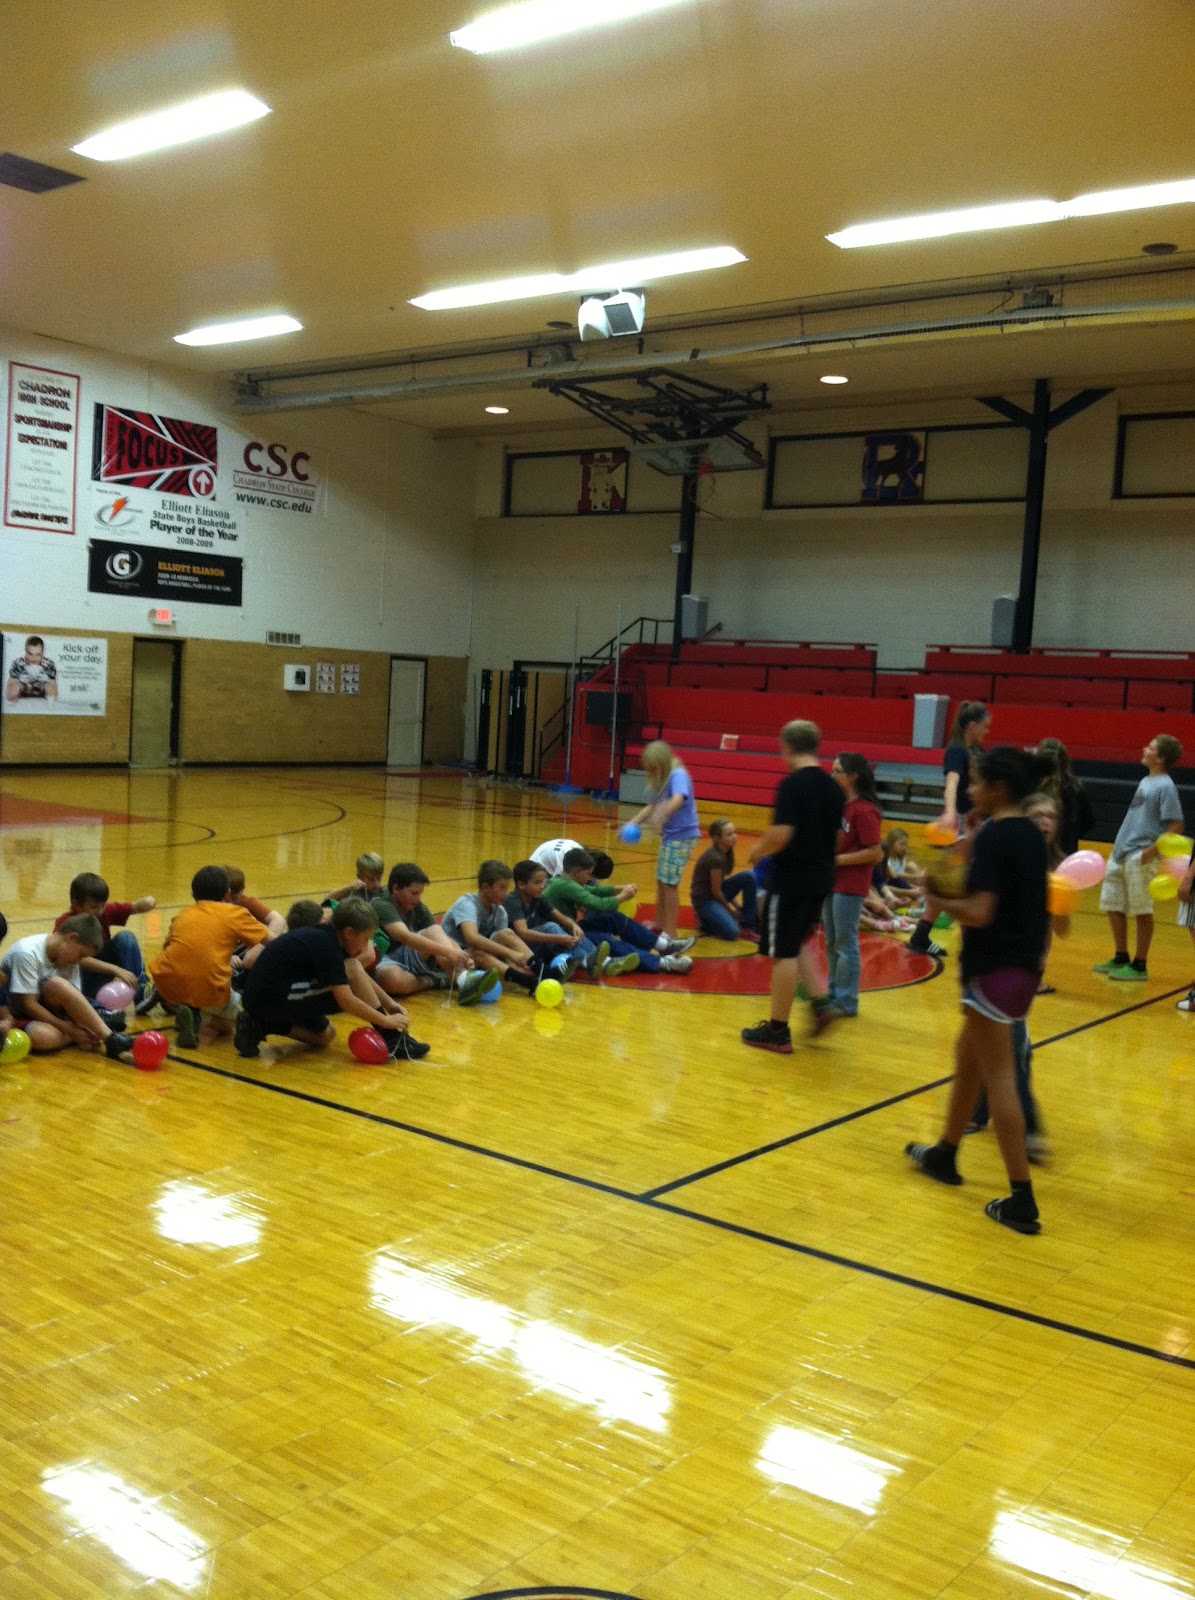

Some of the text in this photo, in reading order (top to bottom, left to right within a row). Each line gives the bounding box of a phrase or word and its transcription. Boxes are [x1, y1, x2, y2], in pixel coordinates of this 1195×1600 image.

[18, 379, 71, 398] CHADRON
[39, 395, 71, 411] SCHOOL
[116, 420, 180, 471] FOCUS
[243, 441, 311, 481] CSC
[161, 499, 230, 520] Elliott Eliason
[236, 492, 313, 514] www.csc.edu
[150, 519, 183, 534] Player
[185, 524, 196, 536] of
[198, 526, 214, 538] the
[216, 528, 239, 541] Year
[153, 510, 237, 530] State Boys Basketball
[176, 536, 214, 548] 2008-2009
[112, 552, 130, 575] G
[157, 560, 225, 577] ELLIOTT ELIASON
[58, 653, 81, 663] your
[63, 643, 99, 654] Kick off
